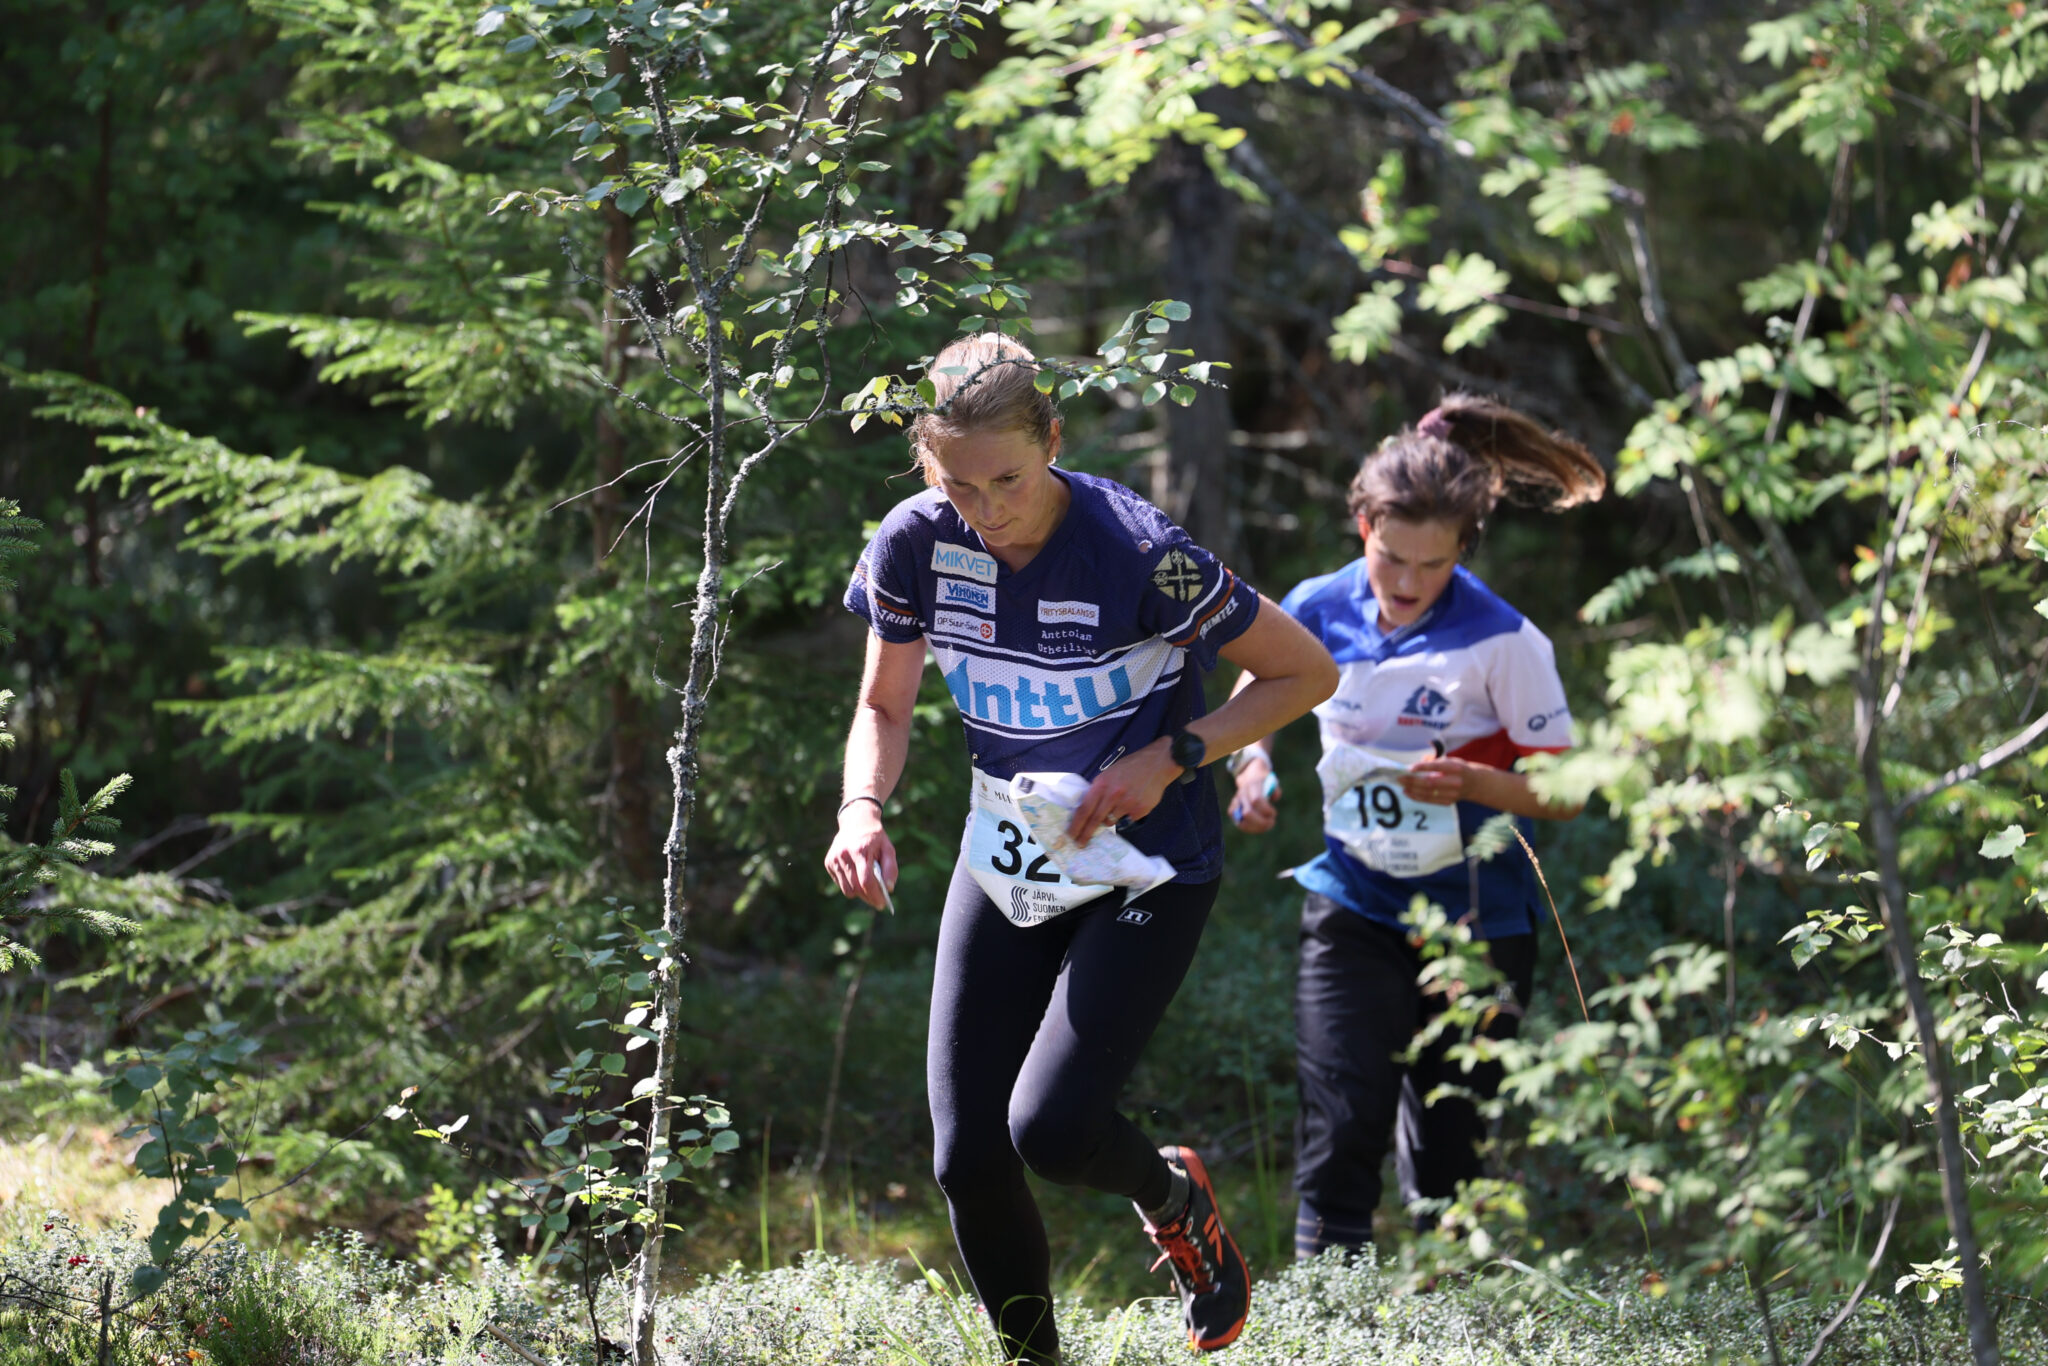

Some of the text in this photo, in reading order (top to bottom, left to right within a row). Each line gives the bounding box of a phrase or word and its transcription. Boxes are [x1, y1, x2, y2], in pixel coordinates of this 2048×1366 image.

[935, 548, 995, 577] MIKVET
[1353, 785, 1429, 831] 19 2
[991, 820, 1061, 884] 32
[1032, 903, 1066, 913] SUOMEN
